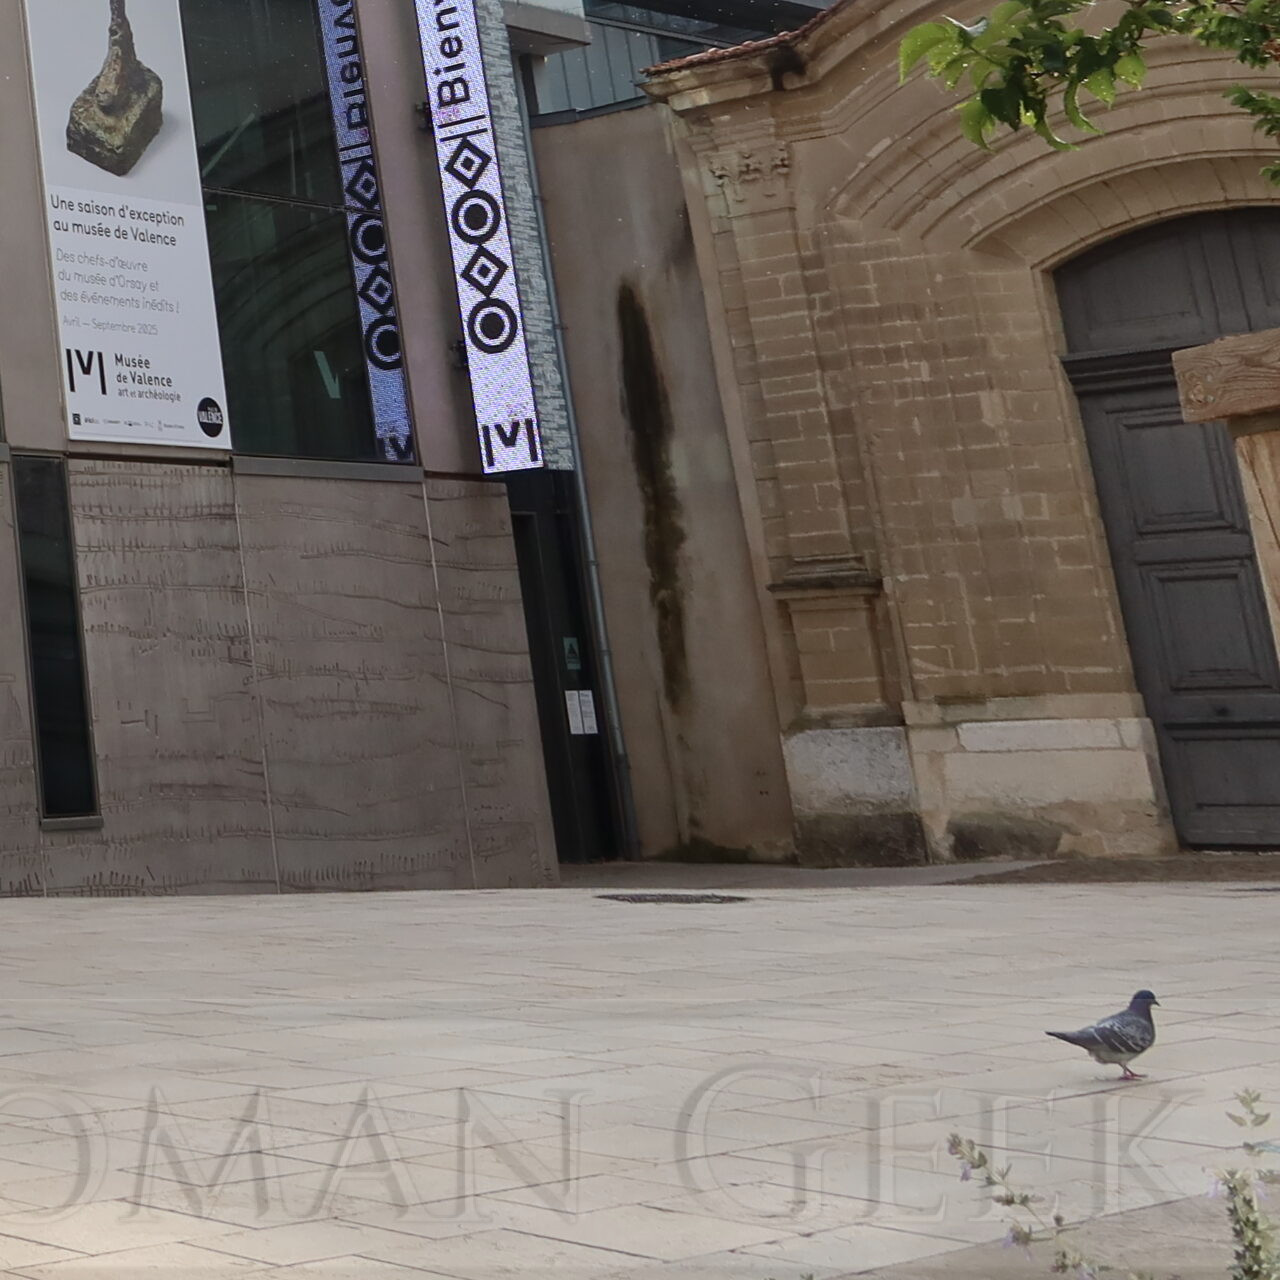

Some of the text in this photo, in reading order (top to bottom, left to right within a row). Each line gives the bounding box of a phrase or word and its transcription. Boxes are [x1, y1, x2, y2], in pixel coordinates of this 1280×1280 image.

[50, 194, 185, 227] Une saison d'exception
[53, 220, 177, 247] au musée de Valence
[56, 248, 76, 264] Des
[57, 269, 161, 294] du musée d'Orsay et
[59, 289, 79, 303] des
[79, 291, 141, 310] événements
[141, 298, 175, 313] inédits
[92, 318, 137, 334] Septembre
[114, 352, 151, 370] Musée
[116, 371, 173, 388] de Valence
[117, 388, 129, 399] art
[137, 389, 182, 404] archéologie
